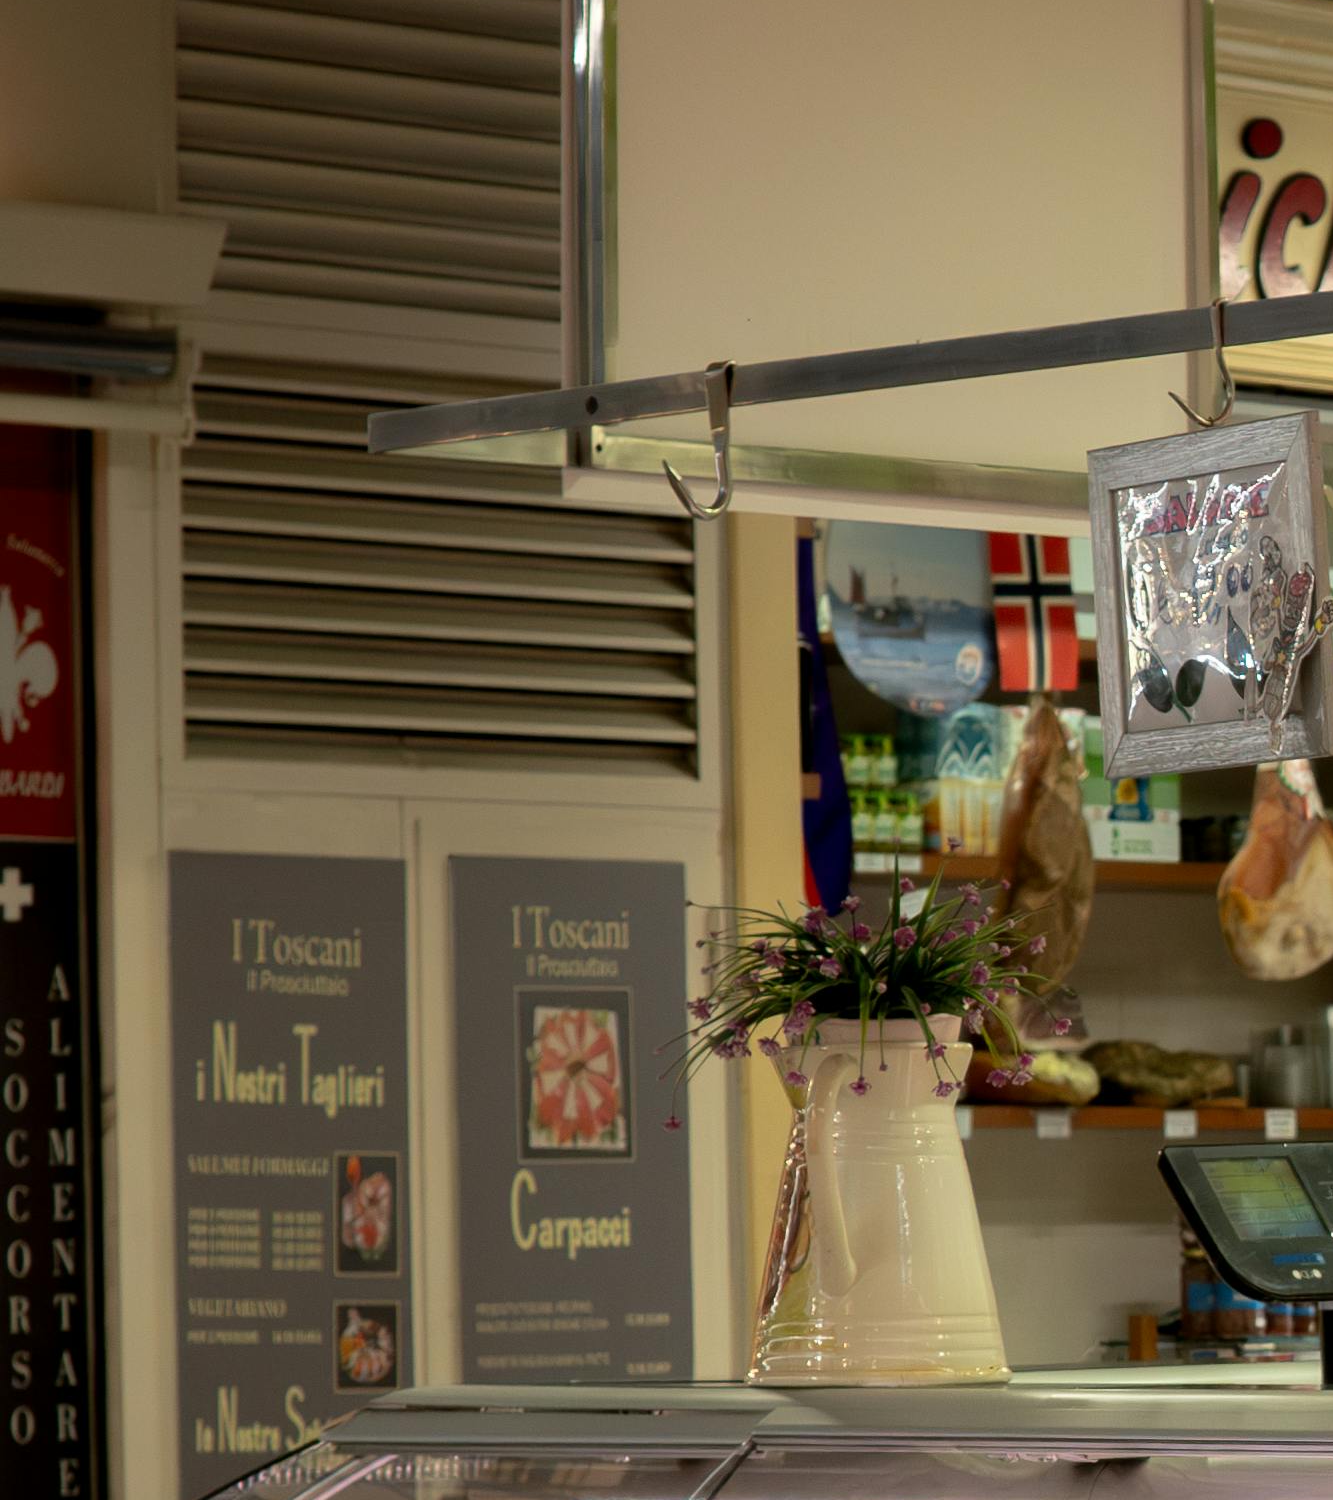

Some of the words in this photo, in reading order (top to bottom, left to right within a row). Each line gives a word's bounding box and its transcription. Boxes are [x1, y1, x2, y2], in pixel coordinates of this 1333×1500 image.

[248, 918, 363, 969] Toscani
[526, 904, 631, 950] Toscani
[213, 1018, 288, 1105] Nostri
[291, 1022, 385, 1119] Taglieri
[3, 1017, 37, 1446] SOCCORSO
[510, 1168, 633, 1261] Carpacci
